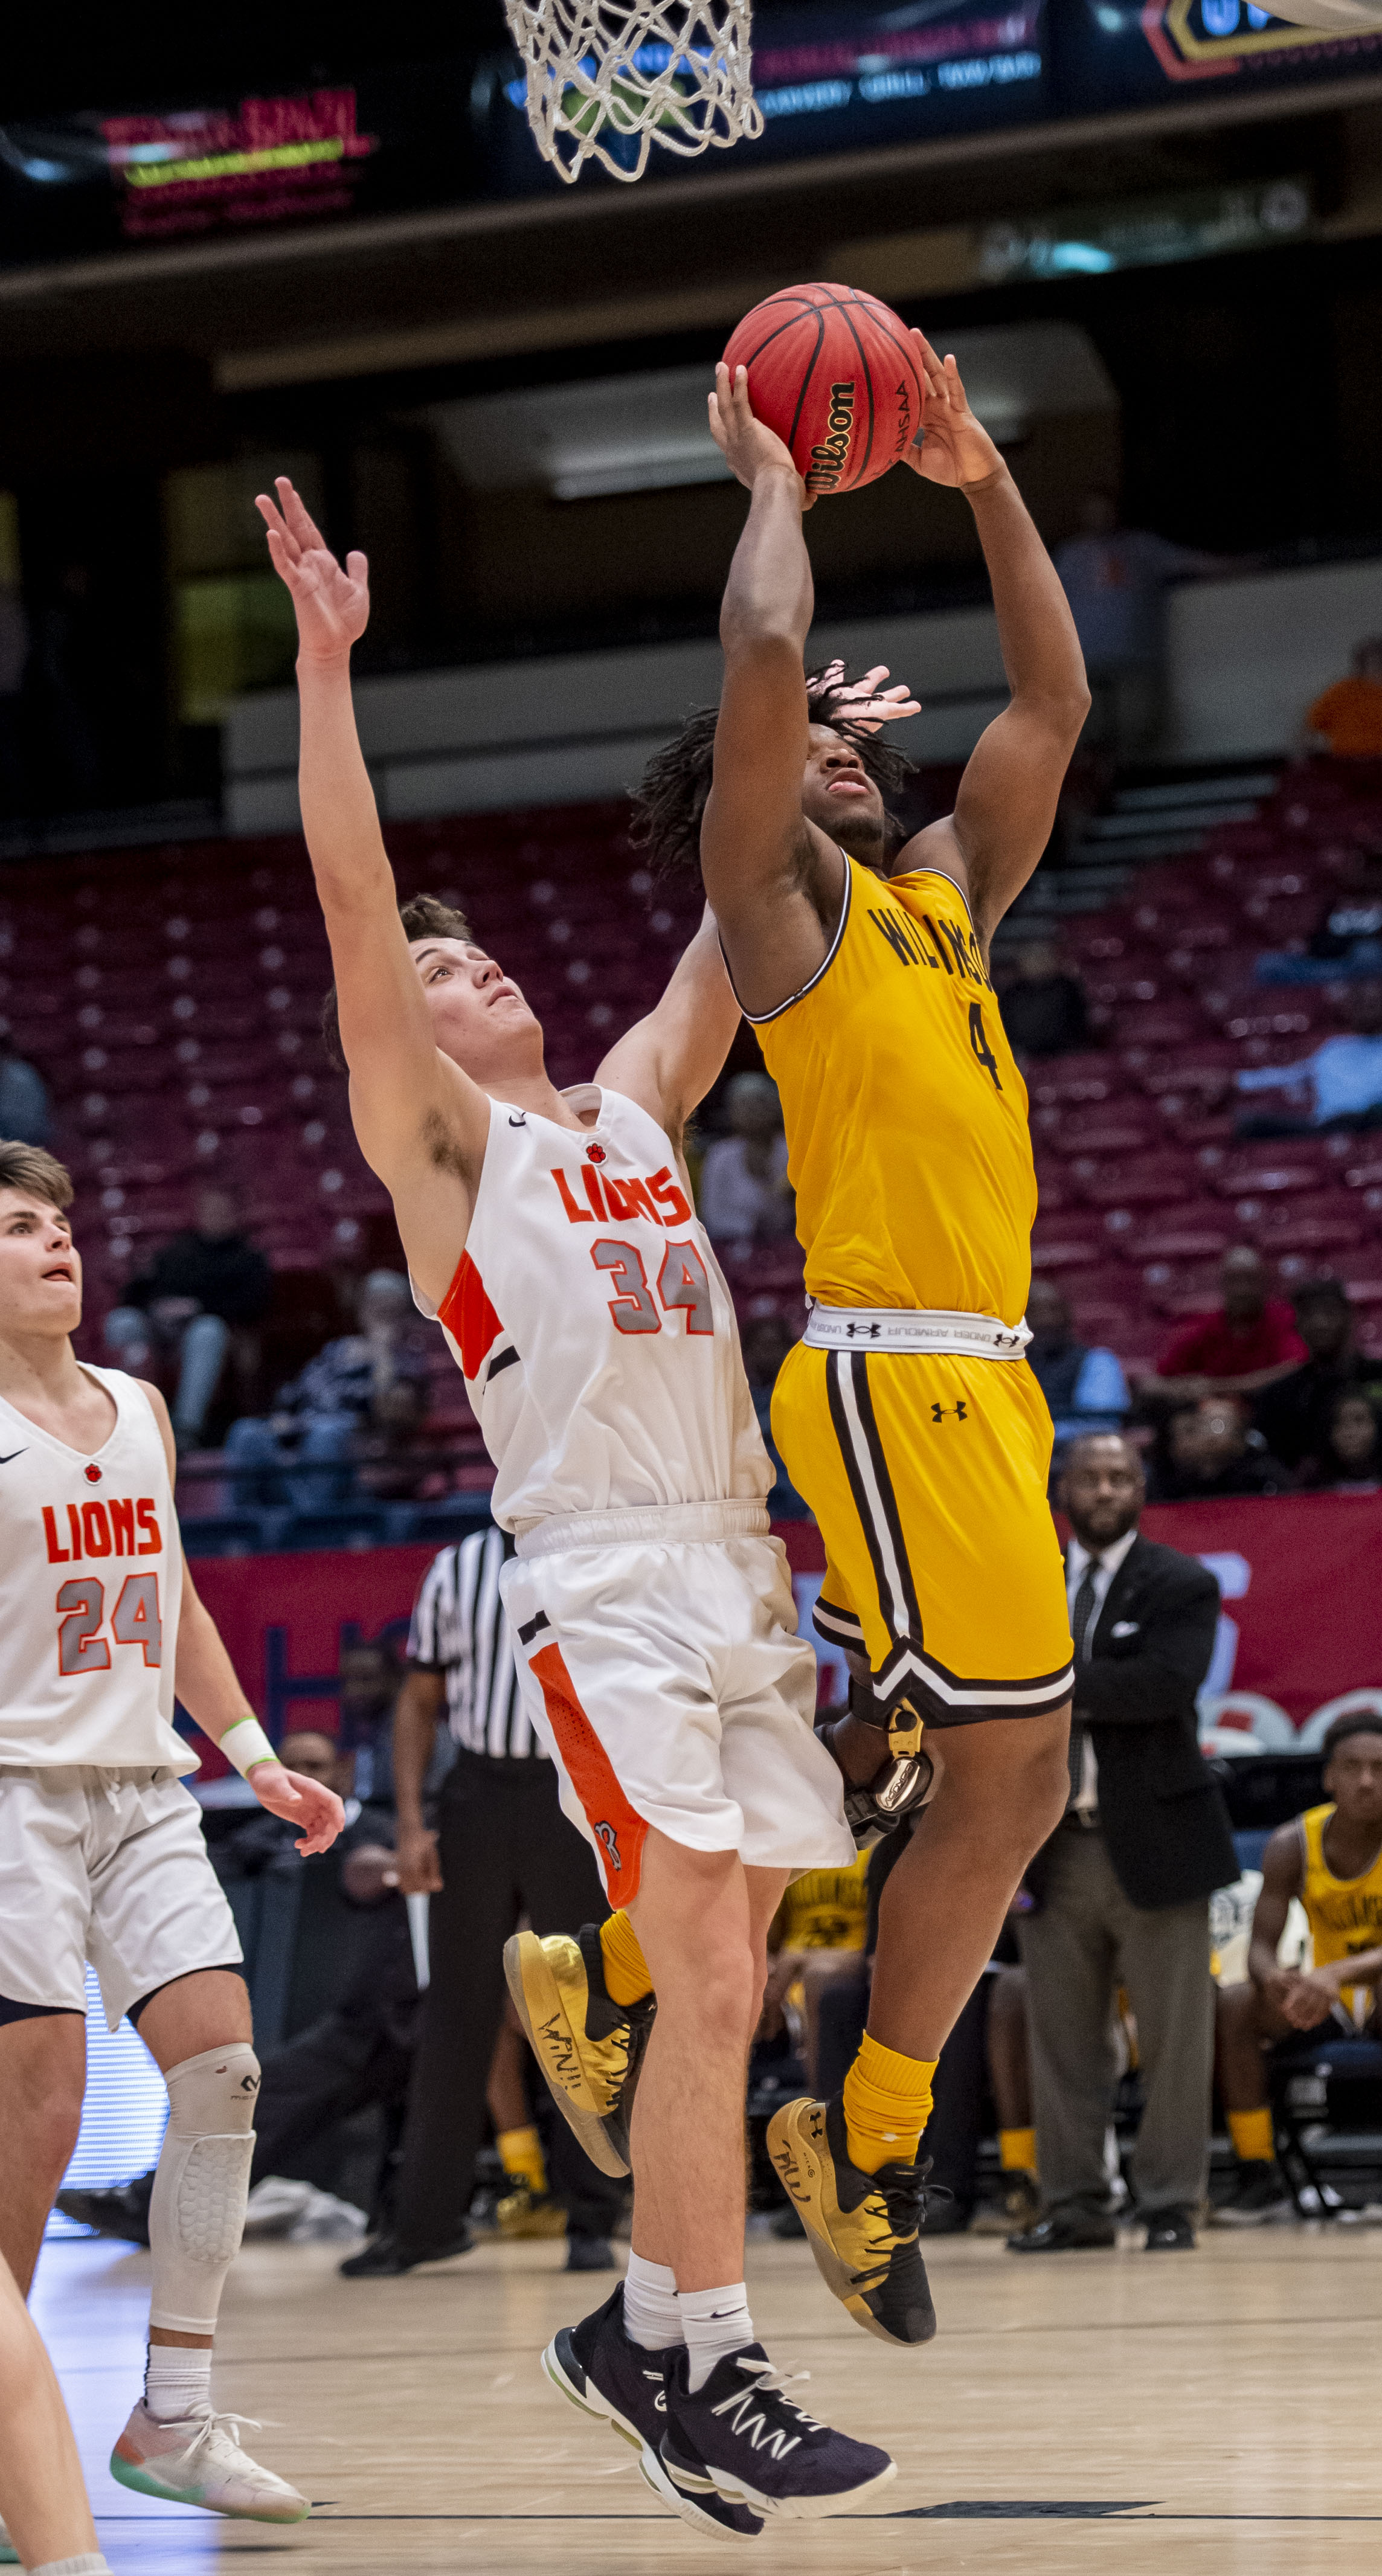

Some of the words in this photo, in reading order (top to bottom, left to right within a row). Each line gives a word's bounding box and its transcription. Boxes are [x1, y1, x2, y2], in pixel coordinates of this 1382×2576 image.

[805, 381, 855, 491] Wilson
[894, 380, 910, 453] AHSAA
[968, 1003, 1003, 1091] 4
[550, 1164, 692, 1227] LIONS
[590, 1238, 714, 1337] 34
[42, 1498, 163, 1564] LIONS
[56, 1572, 162, 1676] 24
